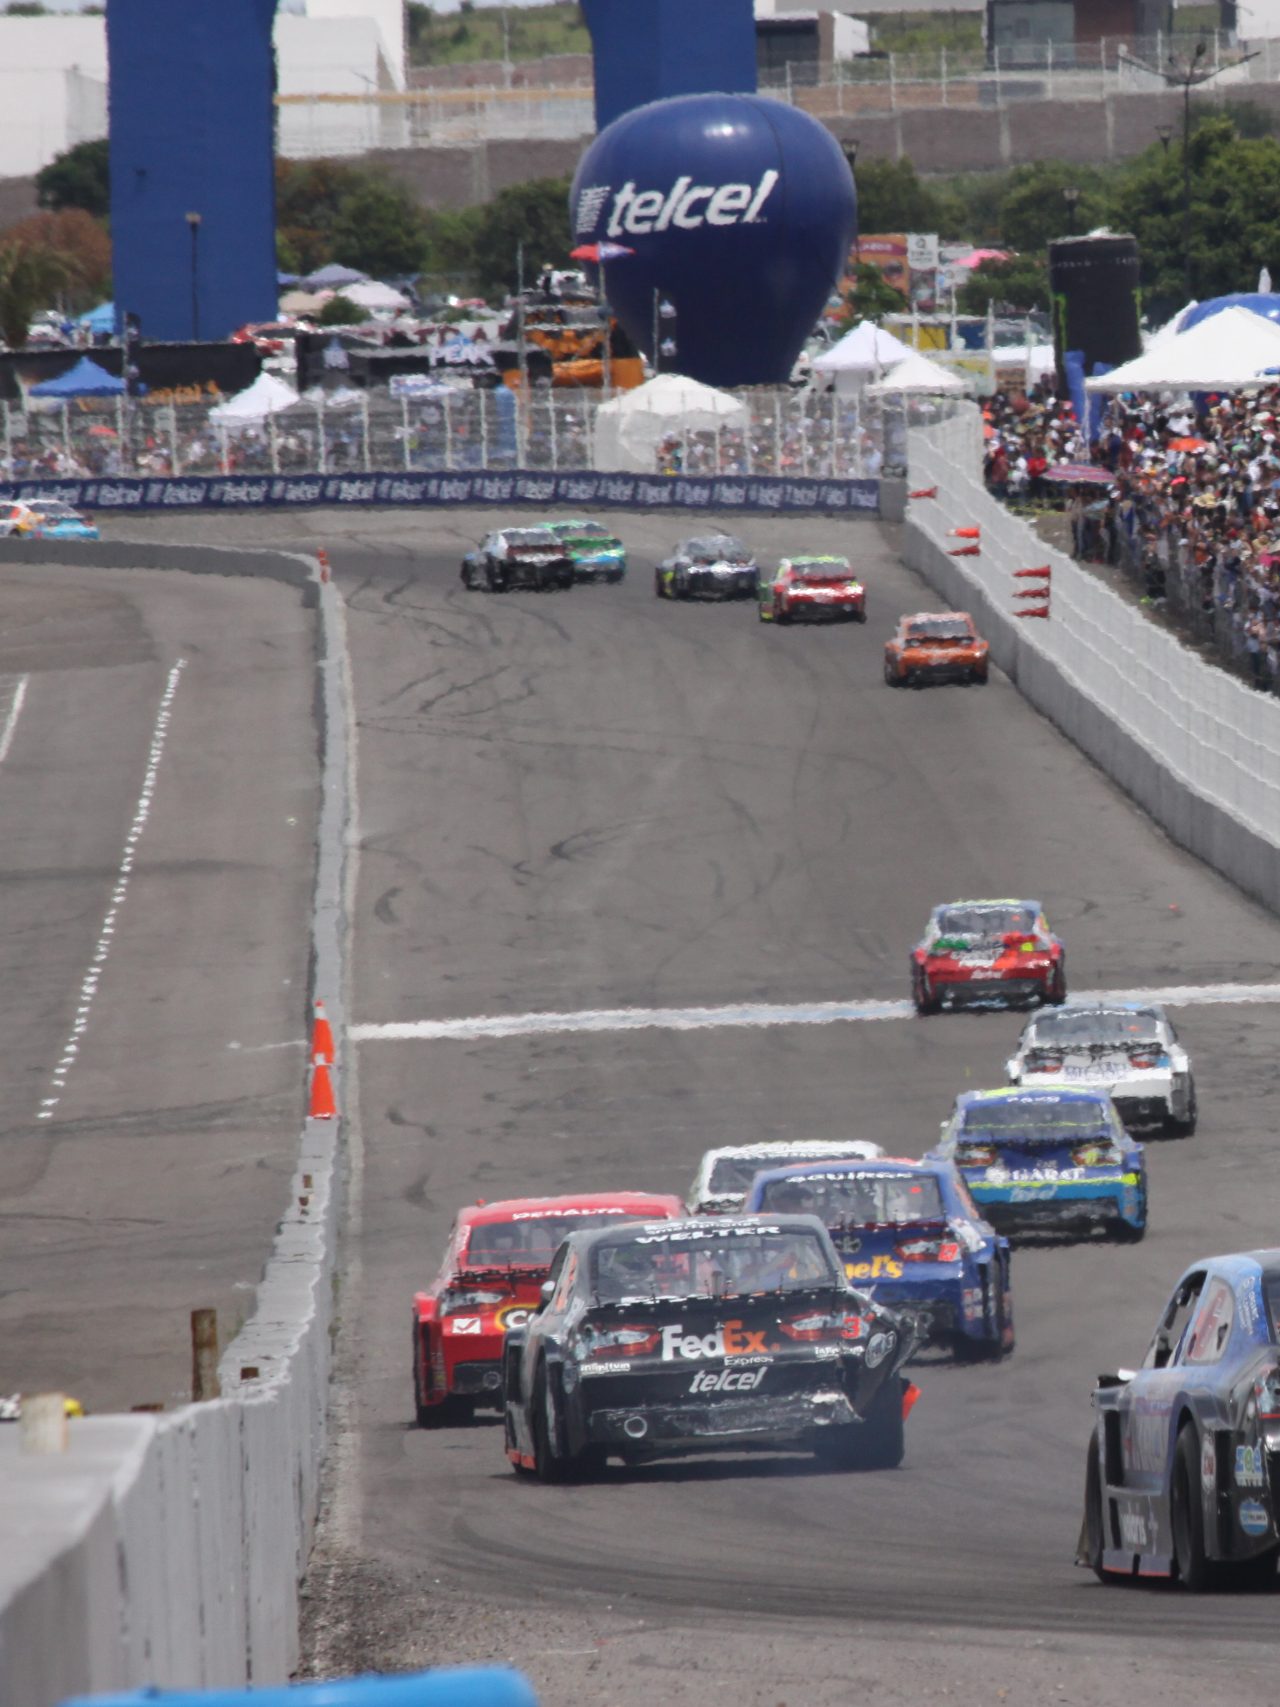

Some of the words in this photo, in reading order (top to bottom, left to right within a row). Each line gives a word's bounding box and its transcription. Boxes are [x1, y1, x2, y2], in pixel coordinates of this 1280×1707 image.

[606, 169, 779, 238] telcel
[635, 1226, 780, 1243] WELTER
[661, 1319, 769, 1361] FedEx
[841, 1317, 861, 1339] 3
[724, 1355, 774, 1367] Express
[688, 1366, 768, 1394] telcel
